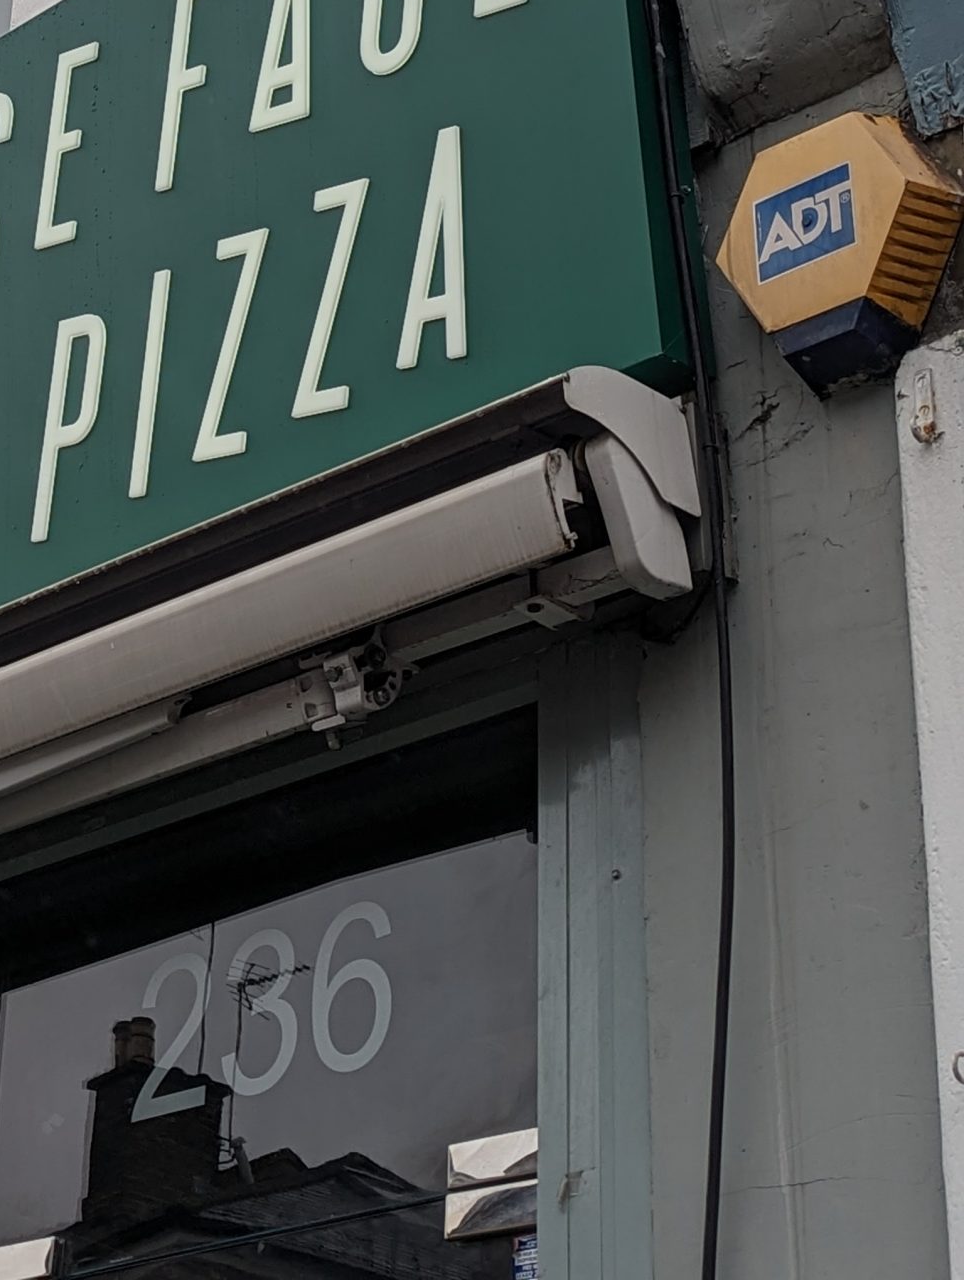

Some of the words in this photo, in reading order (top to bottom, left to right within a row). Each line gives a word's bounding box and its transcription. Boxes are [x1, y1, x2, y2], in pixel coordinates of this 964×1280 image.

[758, 180, 852, 264] ADT
[30, 125, 467, 542] PIZZA
[131, 901, 392, 1123] 236
